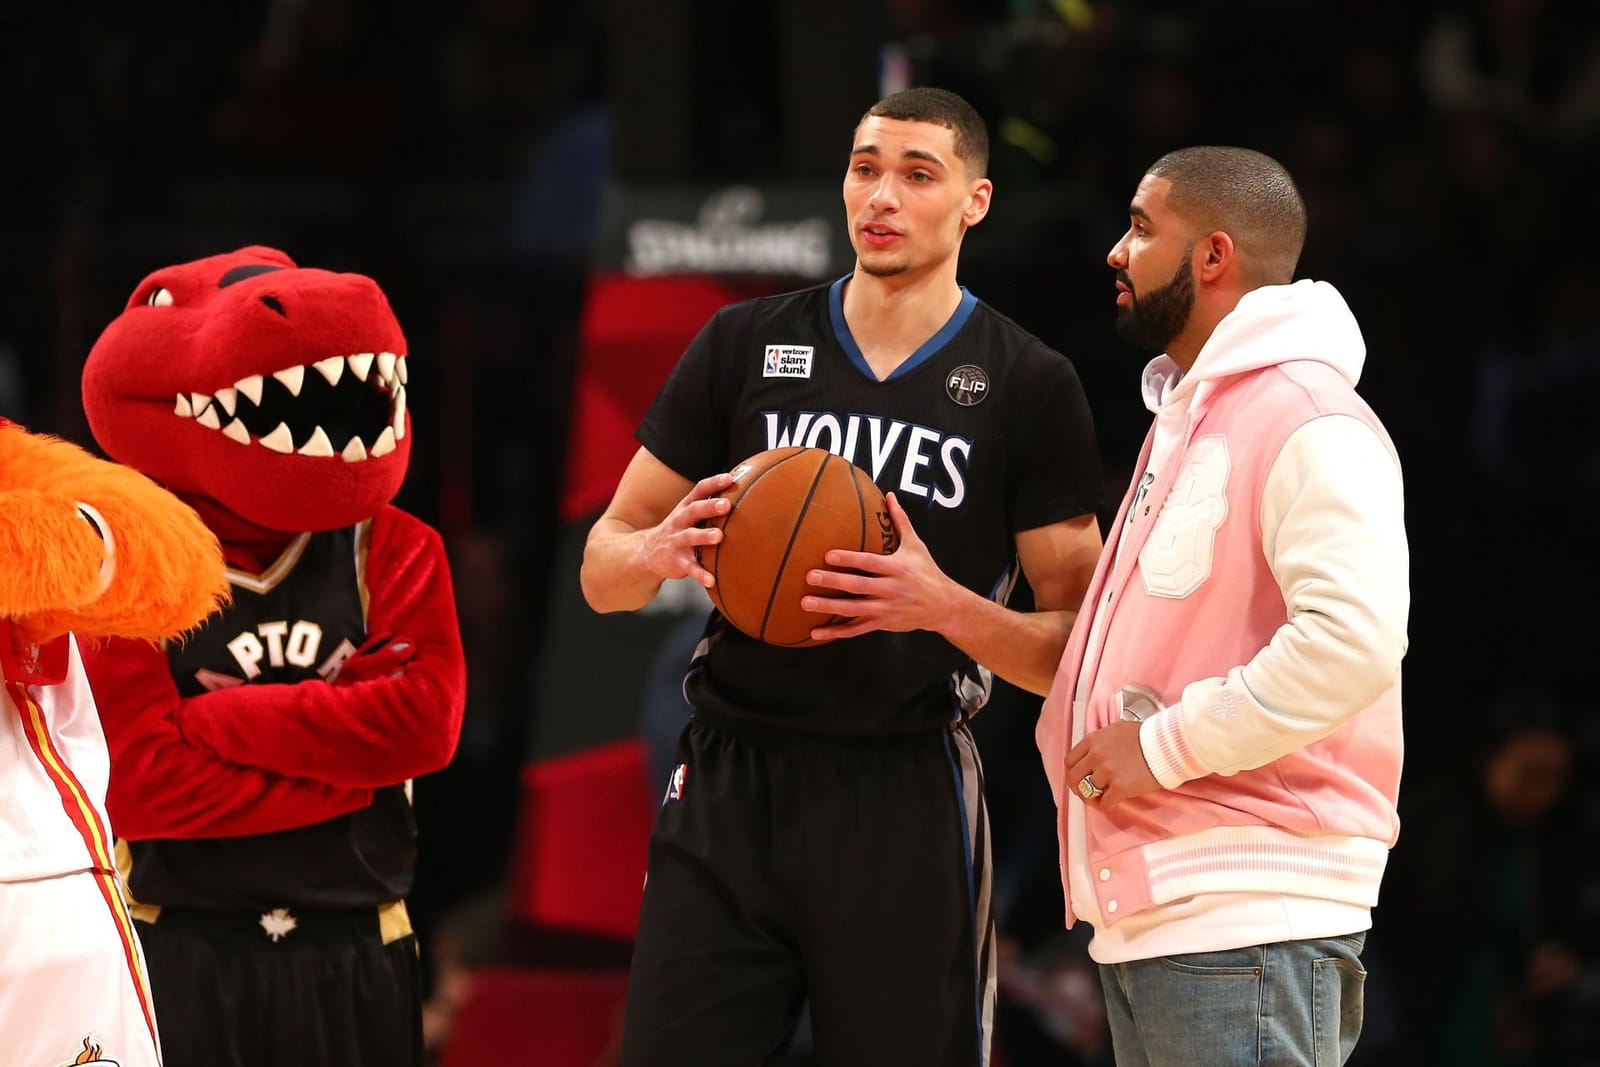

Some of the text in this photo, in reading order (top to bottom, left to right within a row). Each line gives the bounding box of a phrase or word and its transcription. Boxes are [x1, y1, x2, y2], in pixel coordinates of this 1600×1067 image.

[780, 355, 806, 365] slam
[778, 365, 806, 375] dunk
[950, 376, 986, 393] FLIP
